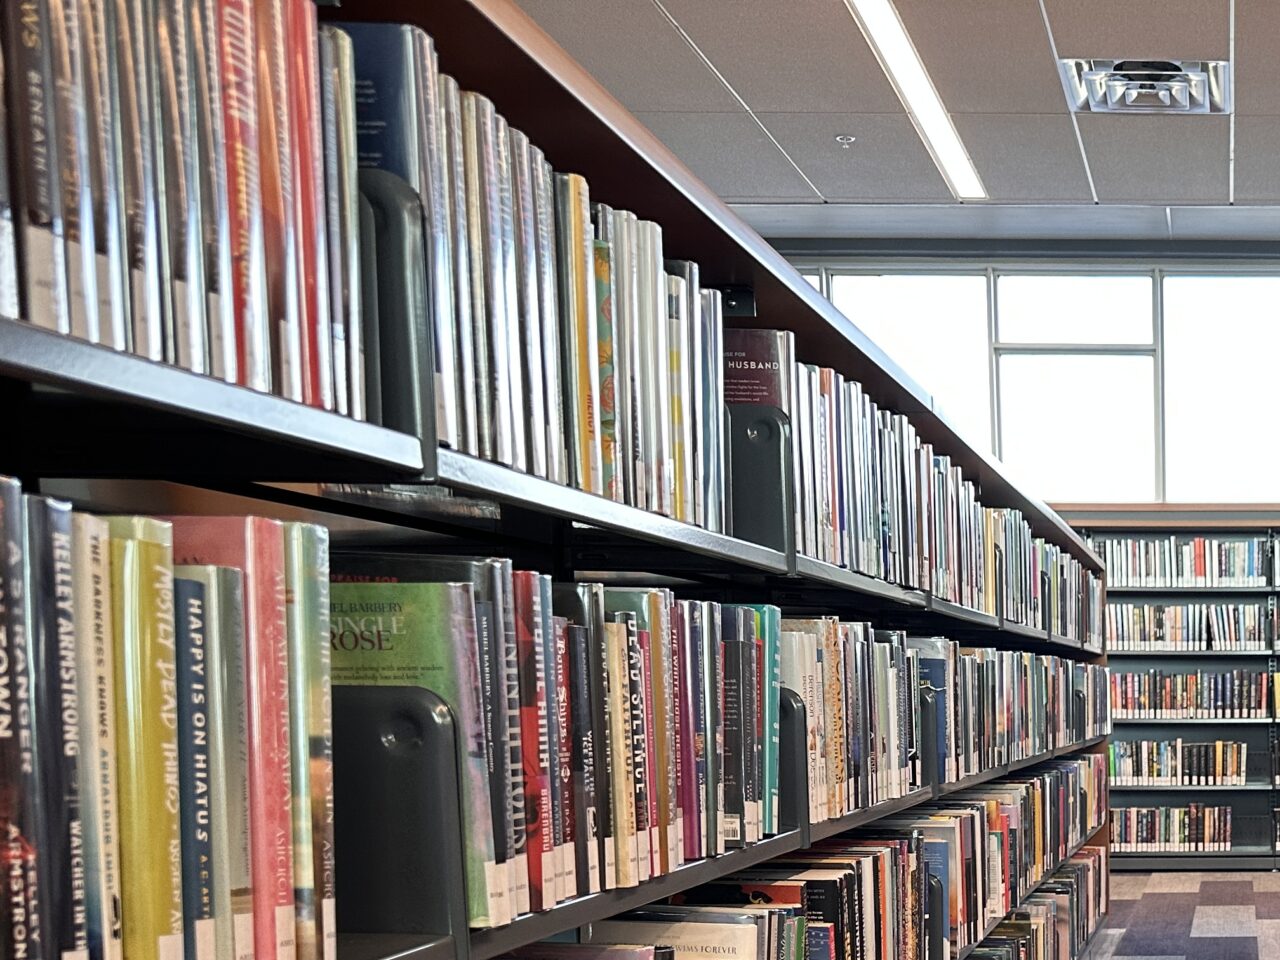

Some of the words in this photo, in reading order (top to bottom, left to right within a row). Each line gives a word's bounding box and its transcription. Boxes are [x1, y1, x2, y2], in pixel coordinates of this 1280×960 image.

[26, 71, 47, 170] BENEATH
[728, 361, 779, 370] HUSBAND
[53, 532, 74, 612] KELLEY
[349, 602, 403, 613] BARBERY
[93, 573, 106, 669] DARKNESS
[152, 564, 175, 653] MOSTLY
[187, 598, 206, 677] HAPPY
[331, 629, 394, 652] ROSE
[481, 616, 491, 652] MURIEL
[12, 578, 33, 774] STRANGER
[57, 617, 80, 757] ARMSTRONG
[156, 659, 178, 730] DEAD
[192, 682, 206, 705] IS
[556, 637, 567, 681] Bone
[98, 675, 110, 740] KNOWS
[193, 712, 207, 746] ON
[485, 712, 494, 740] Strange
[557, 685, 569, 740] Ships
[162, 742, 180, 814] THINGS
[487, 742, 496, 773] Country
[631, 693, 646, 795] SILENCE
[194, 755, 209, 842] HIATUS
[69, 820, 87, 900] WATCHER
[27, 853, 41, 943] KELLEY
[73, 905, 87, 924] IN
